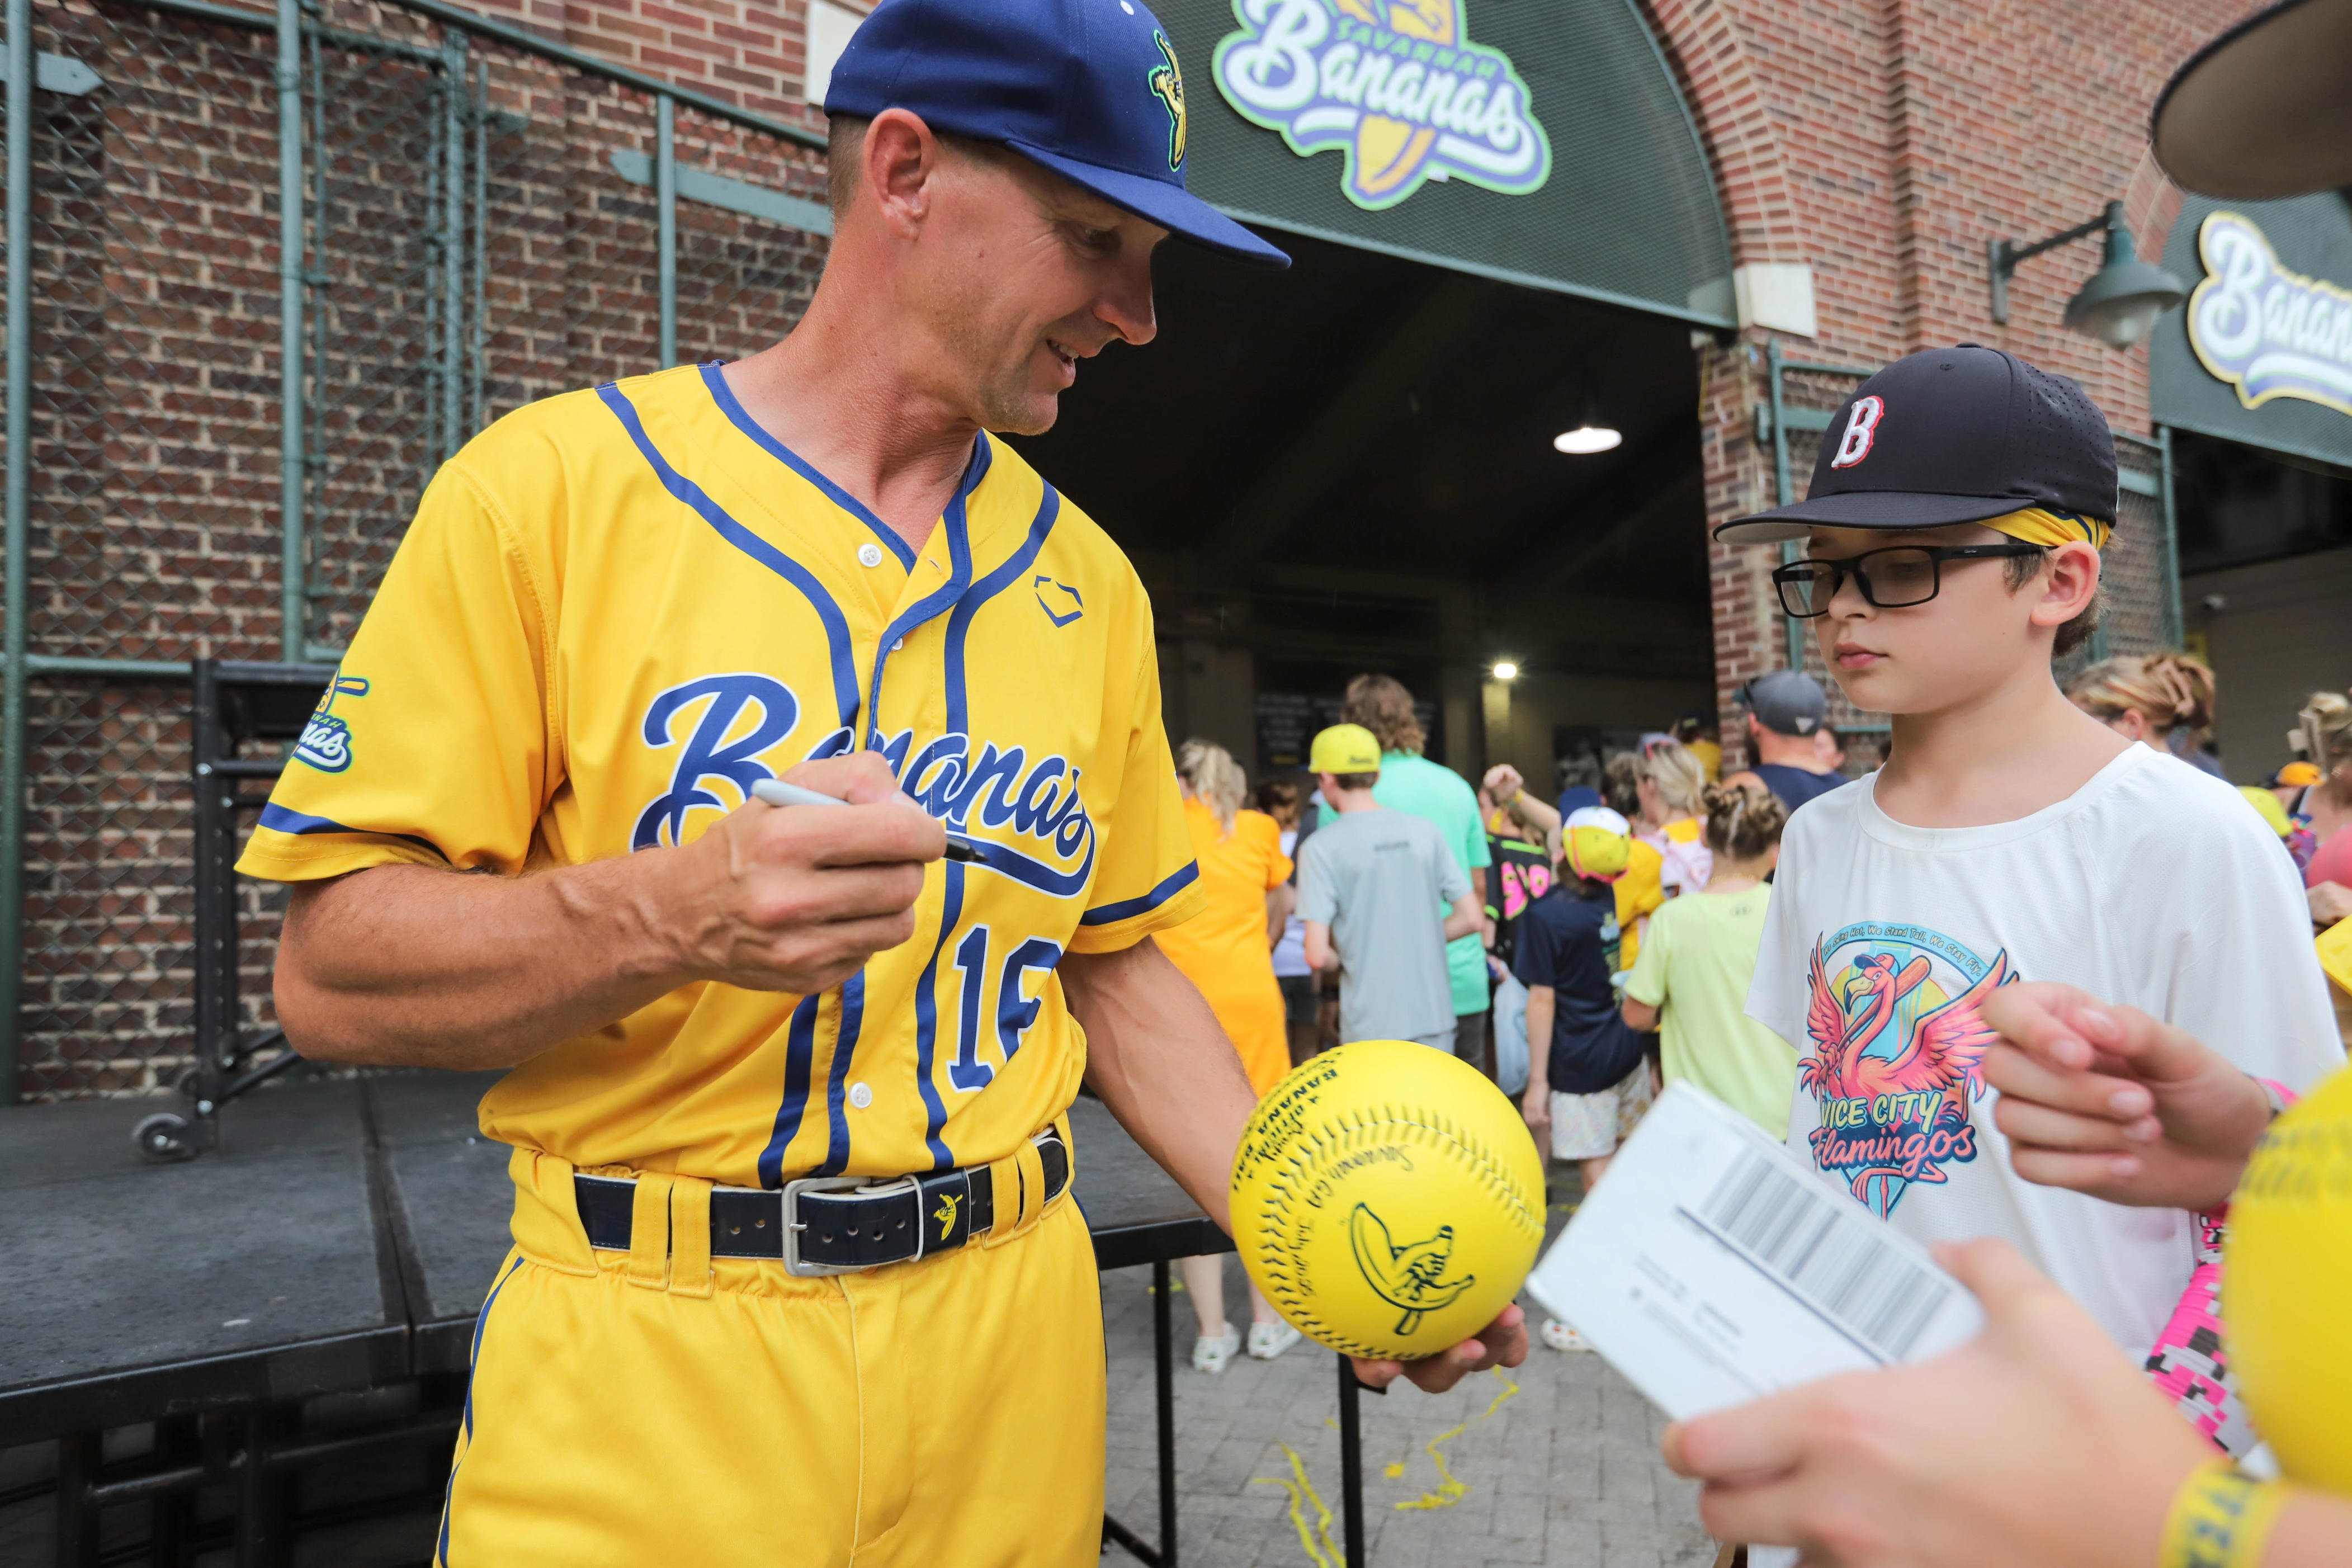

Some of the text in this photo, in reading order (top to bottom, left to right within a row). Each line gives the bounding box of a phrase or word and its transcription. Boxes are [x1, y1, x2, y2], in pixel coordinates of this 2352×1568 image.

[1225, 0, 1533, 168] Bananas
[1831, 395, 1885, 470] B
[1850, 925, 1865, 937] Hot,
[1868, 924, 1882, 935] We
[1885, 925, 1908, 937] Stand
[1910, 928, 1926, 943] Tall,
[1930, 934, 1944, 948] We
[1945, 943, 1967, 963] Stay
[1966, 957, 1981, 976] Fly.
[1258, 1068, 1339, 1135] BANANA
[1822, 1091, 1943, 1134] VICE CITY
[1809, 1125, 1973, 1178] Flamingos
